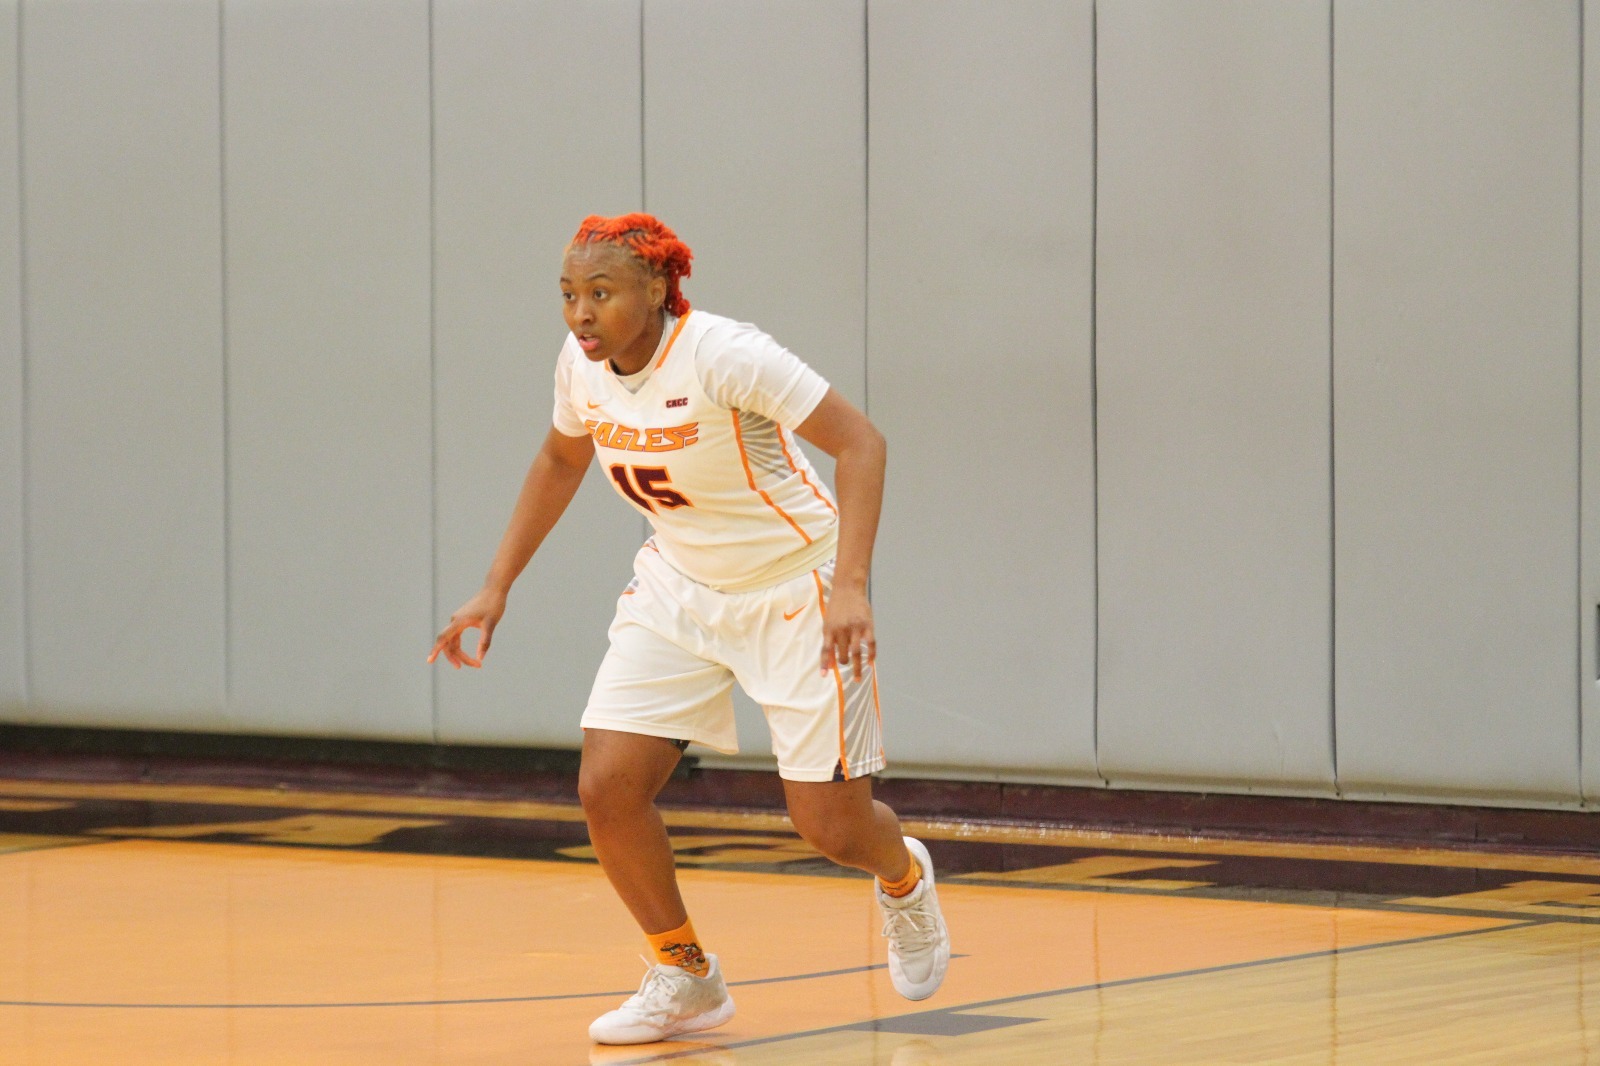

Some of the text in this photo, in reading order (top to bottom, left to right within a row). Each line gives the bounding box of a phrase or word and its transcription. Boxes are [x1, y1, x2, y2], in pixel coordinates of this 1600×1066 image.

[666, 397, 688, 408] CACC
[584, 419, 699, 452] EAGLES
[609, 463, 695, 516] 15
